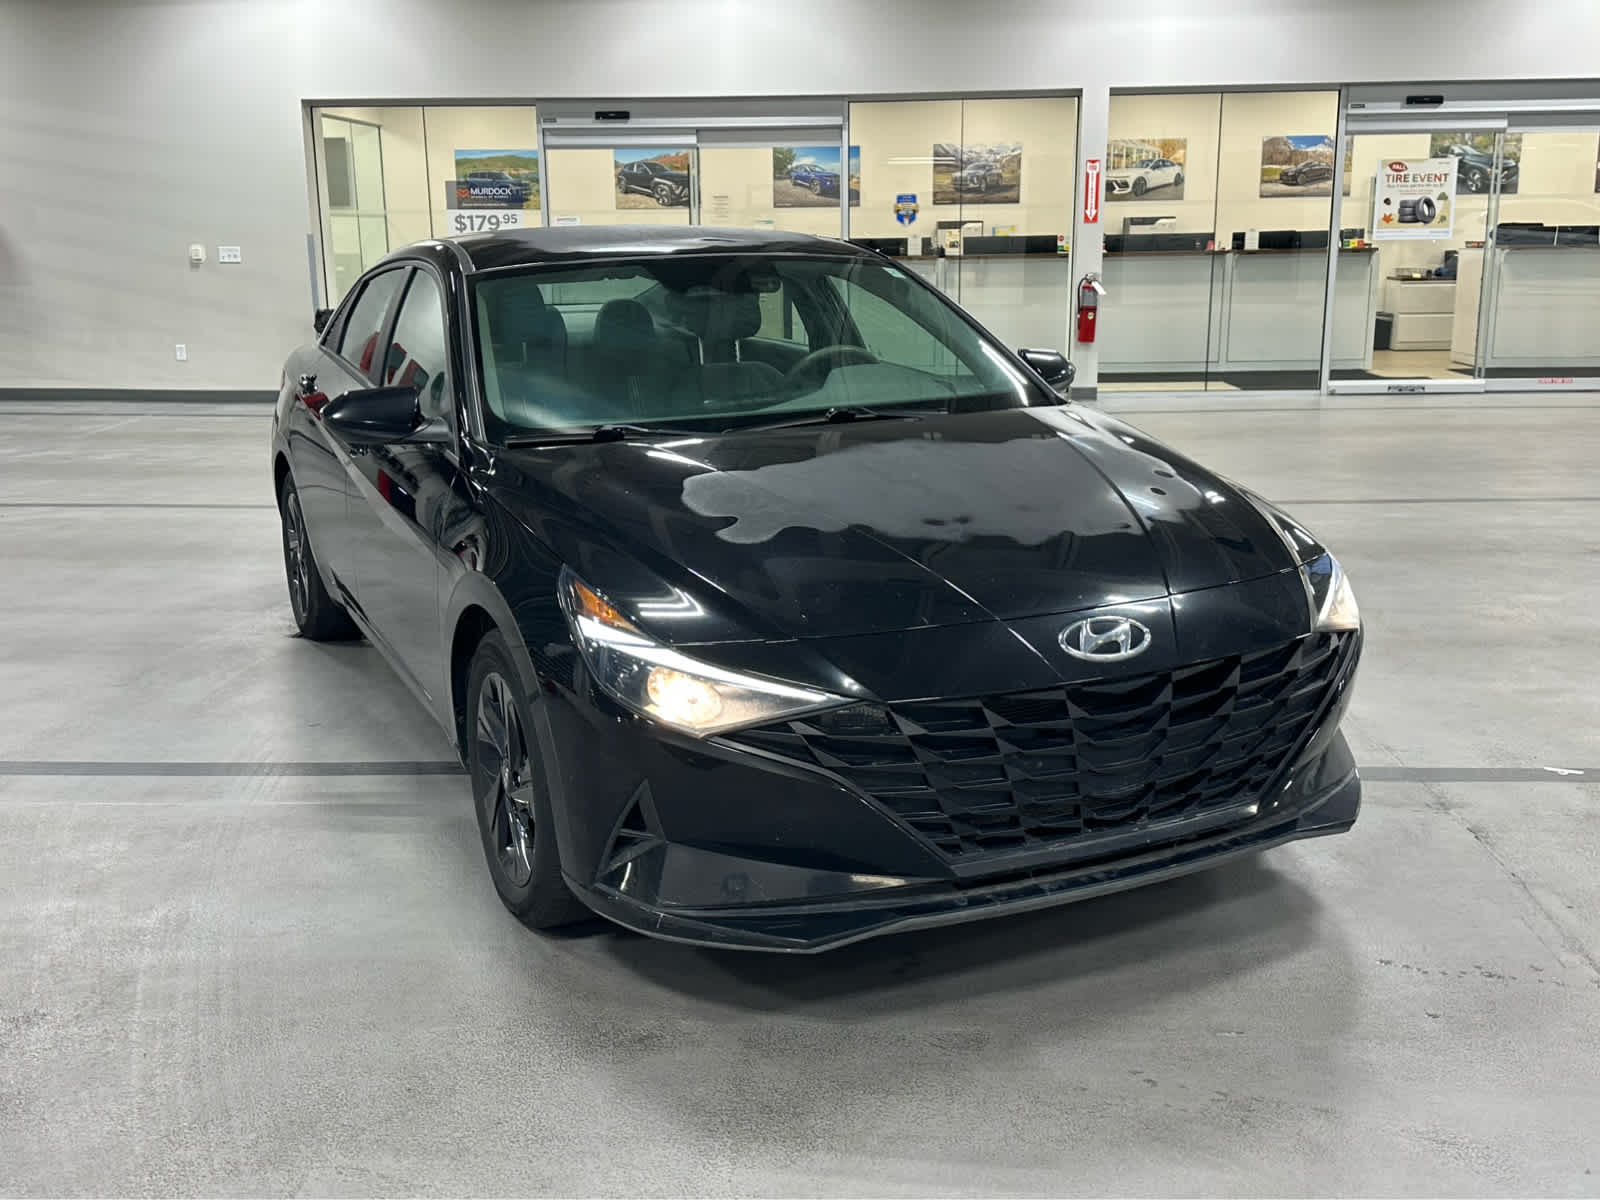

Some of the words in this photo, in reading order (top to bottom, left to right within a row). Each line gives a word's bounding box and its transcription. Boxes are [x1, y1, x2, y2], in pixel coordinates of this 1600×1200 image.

[1385, 173, 1410, 183] TIRE
[1412, 173, 1449, 183] EVENT
[470, 187, 513, 195] MURDOCK
